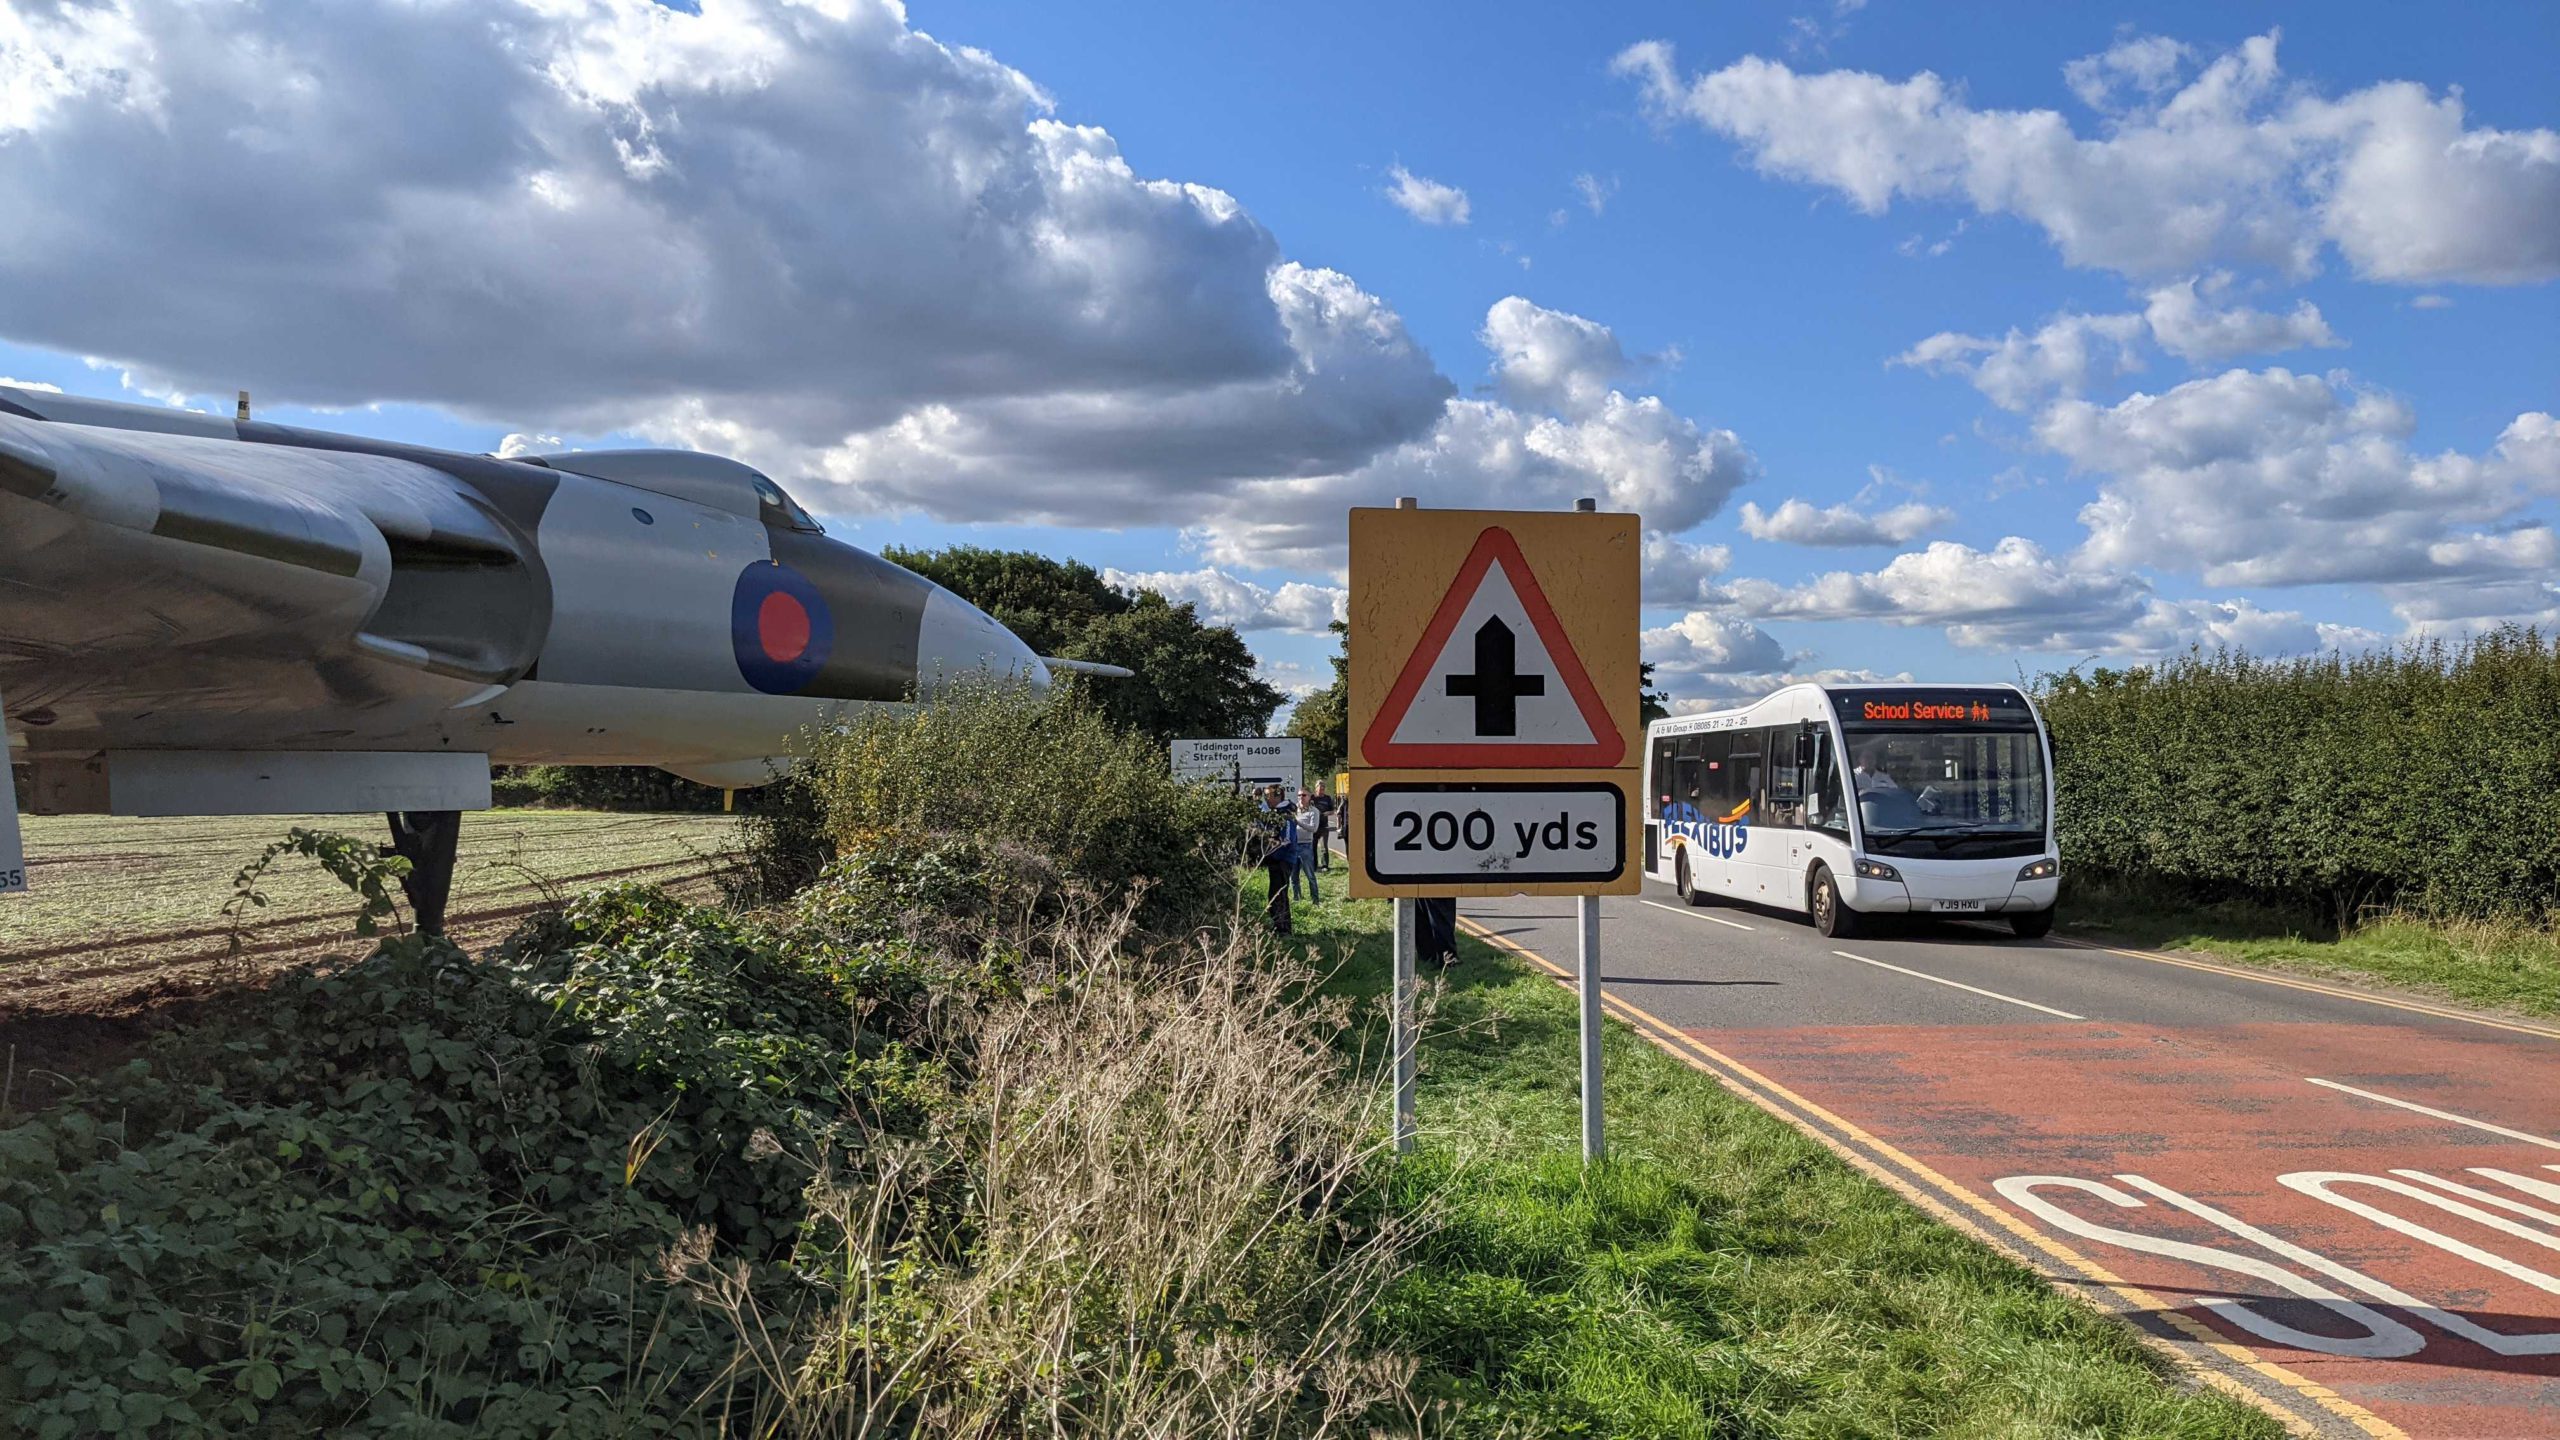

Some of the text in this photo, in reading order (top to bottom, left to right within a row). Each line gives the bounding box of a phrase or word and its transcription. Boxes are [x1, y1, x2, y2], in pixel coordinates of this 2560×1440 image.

[1864, 701, 1965, 719] School Service
[1672, 724, 1688, 733] Group
[1712, 720, 1719, 729] 21
[1725, 718, 1734, 727] 22
[1739, 716, 1748, 726] 25
[1193, 742, 1245, 752] Tiddington
[1247, 746, 1281, 755] B4086
[1193, 752, 1239, 761] Stratford
[1393, 810, 1598, 859] 200 yds
[1663, 802, 1749, 859] FLEXIBUS
[1939, 900, 1979, 910] YJ19 HXU
[1992, 1164, 2560, 1359] SLO
